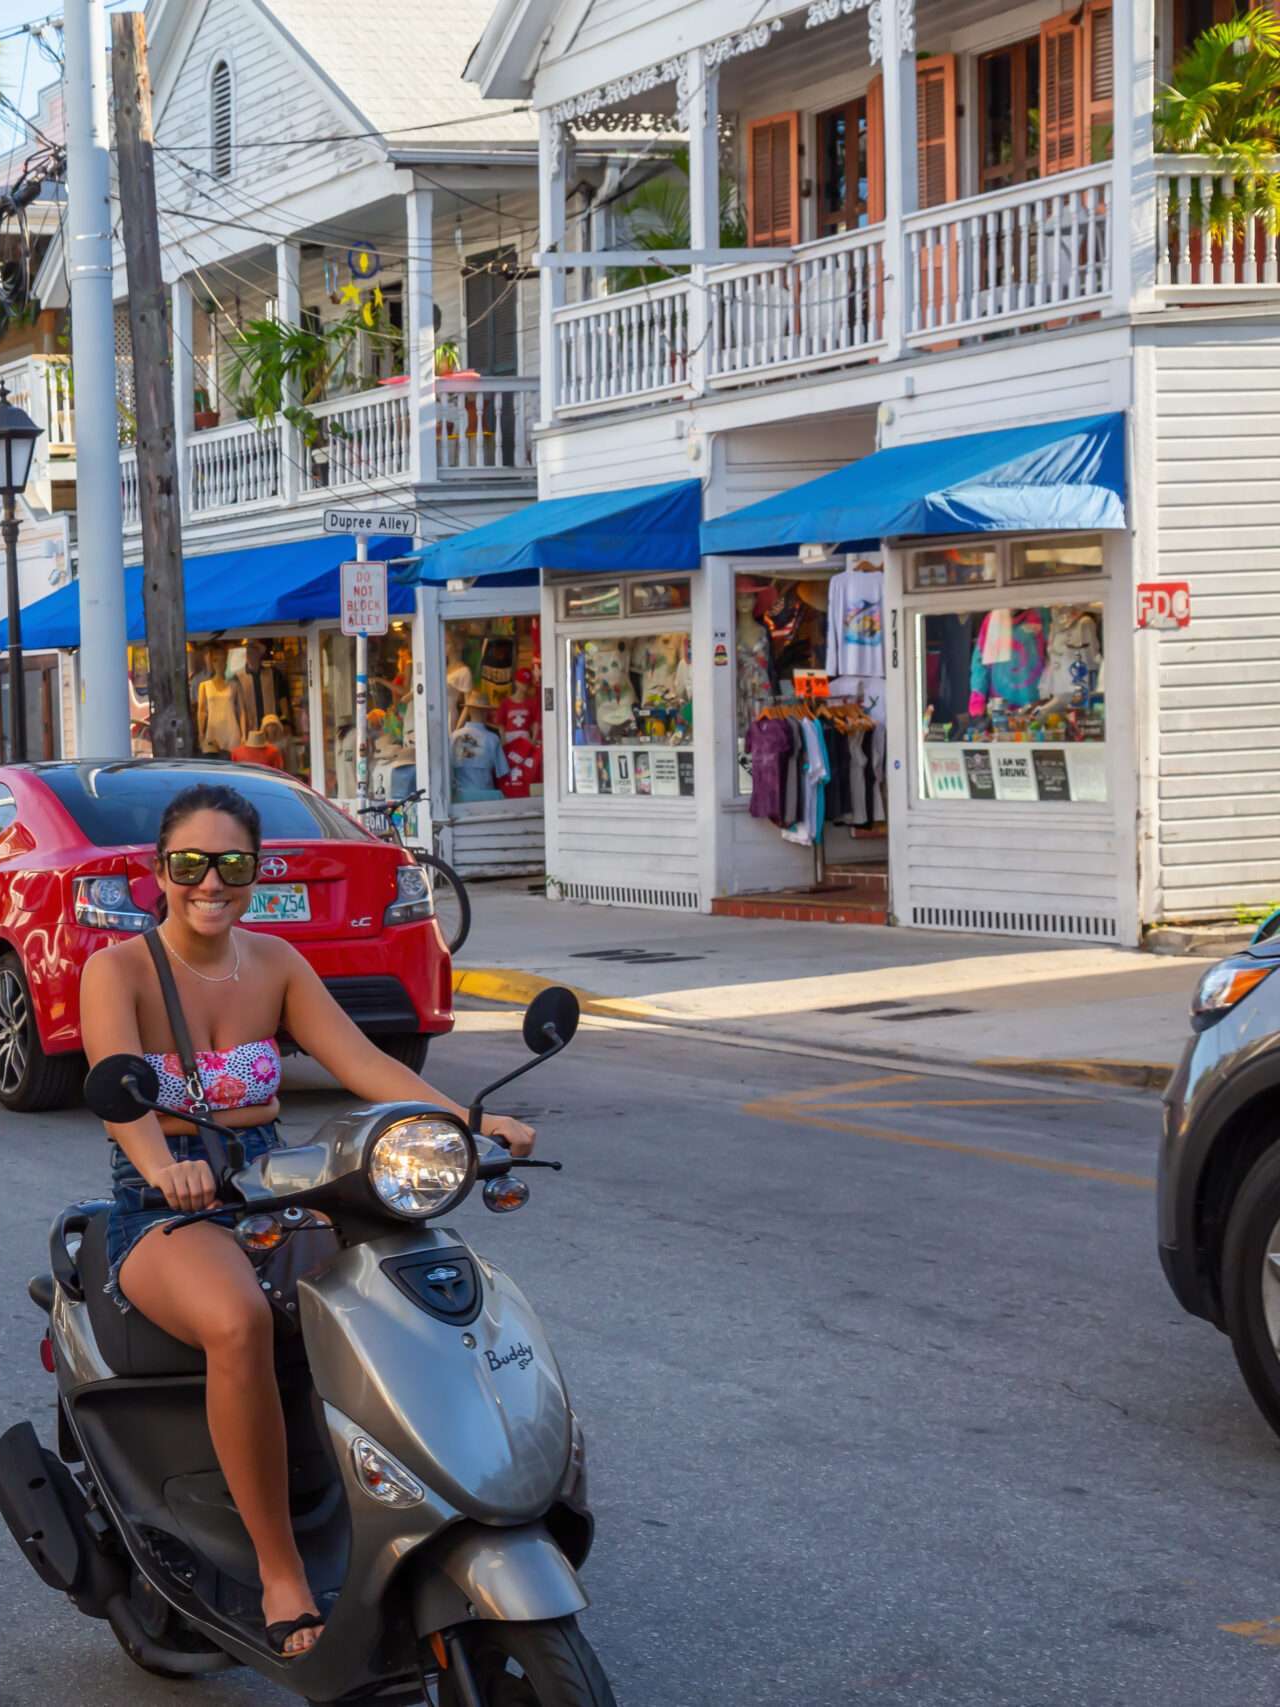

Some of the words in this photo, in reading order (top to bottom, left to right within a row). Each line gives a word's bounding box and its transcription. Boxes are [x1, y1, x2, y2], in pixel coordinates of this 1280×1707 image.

[330, 514, 372, 530] Dupree
[378, 517, 410, 532] Alley
[356, 571, 371, 582] DO
[353, 586, 373, 596] NOT
[347, 600, 382, 612] BLOCK
[348, 615, 381, 626] ALLEY
[891, 609, 899, 669] 718
[483, 1342, 534, 1371] Buddy
